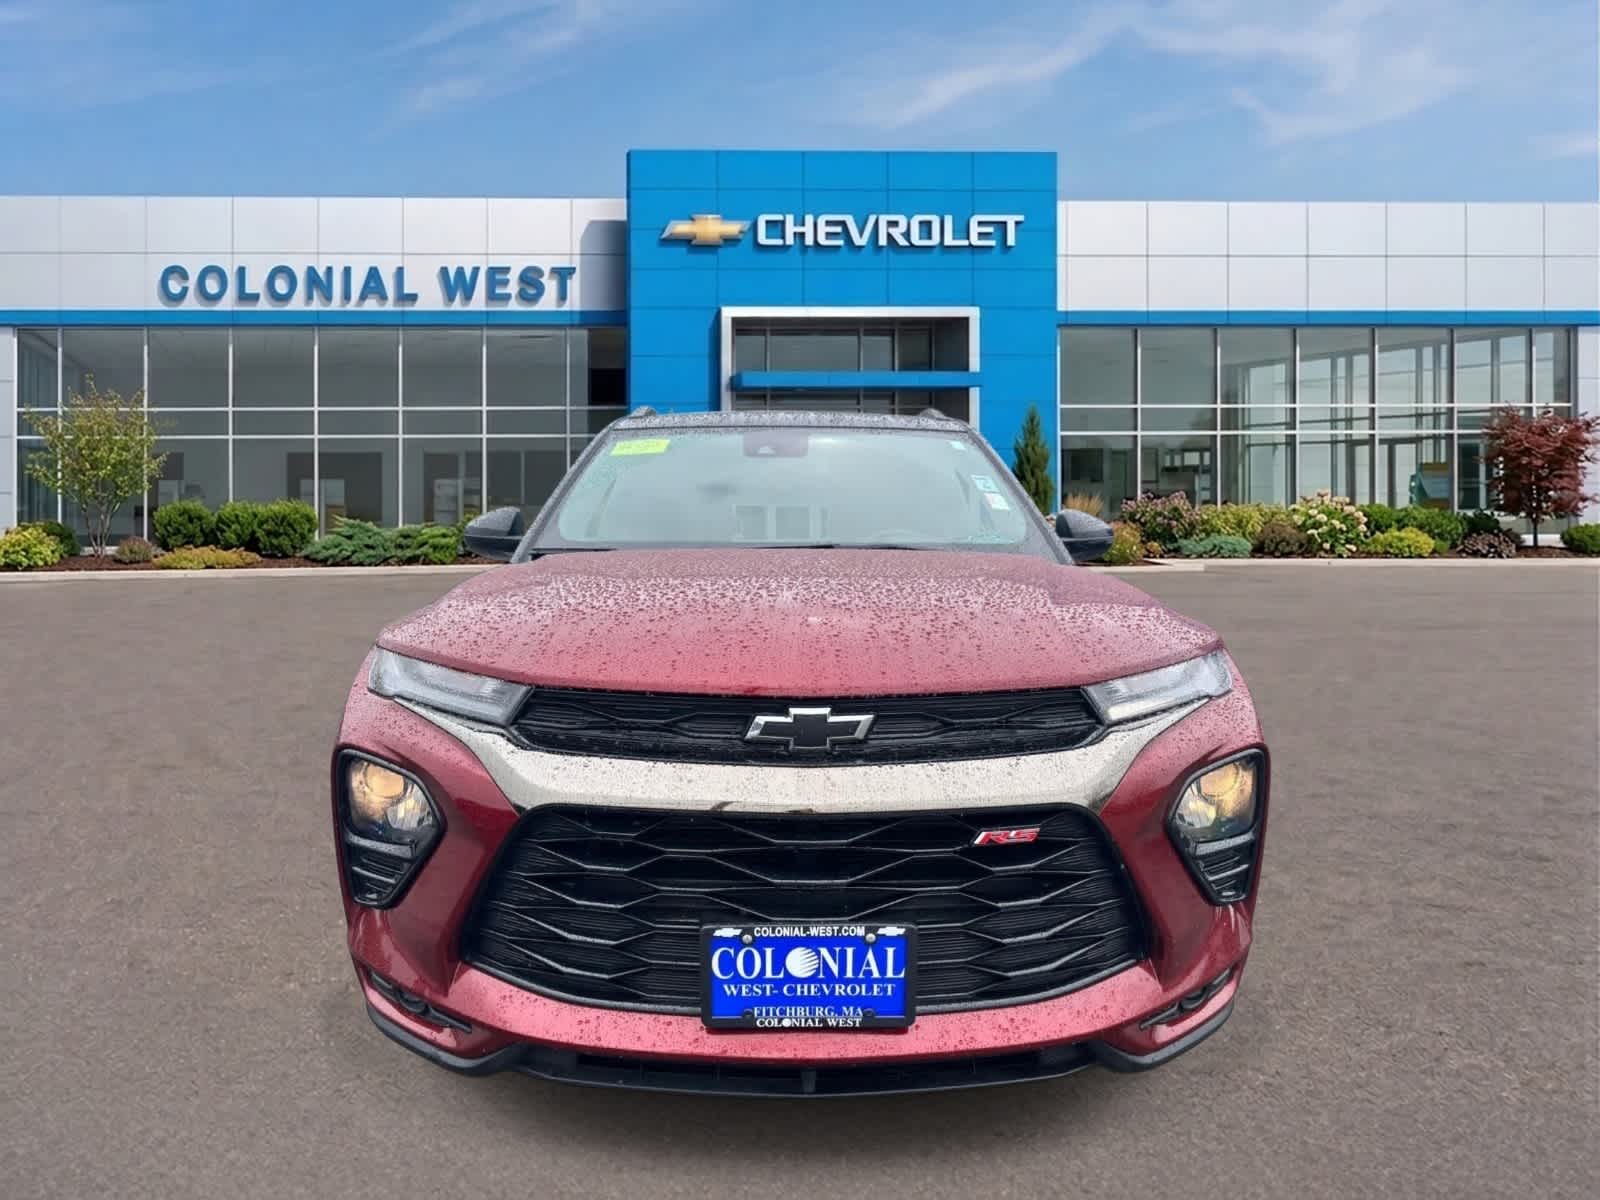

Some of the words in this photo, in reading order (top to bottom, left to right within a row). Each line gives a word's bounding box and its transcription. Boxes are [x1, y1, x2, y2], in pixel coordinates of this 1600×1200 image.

[757, 213, 1025, 248] CHEVROLET
[160, 264, 418, 306] COLONIAL
[438, 265, 577, 306] WEST
[974, 827, 1040, 845] RS
[753, 926, 866, 937] COLONIAL-WEST.COM
[711, 946, 905, 980] COLONIAL
[783, 983, 896, 996] CHEVROLET
[842, 1005, 863, 1017] MA
[756, 1018, 823, 1028] COLONIAL
[827, 1018, 862, 1027] WEST
